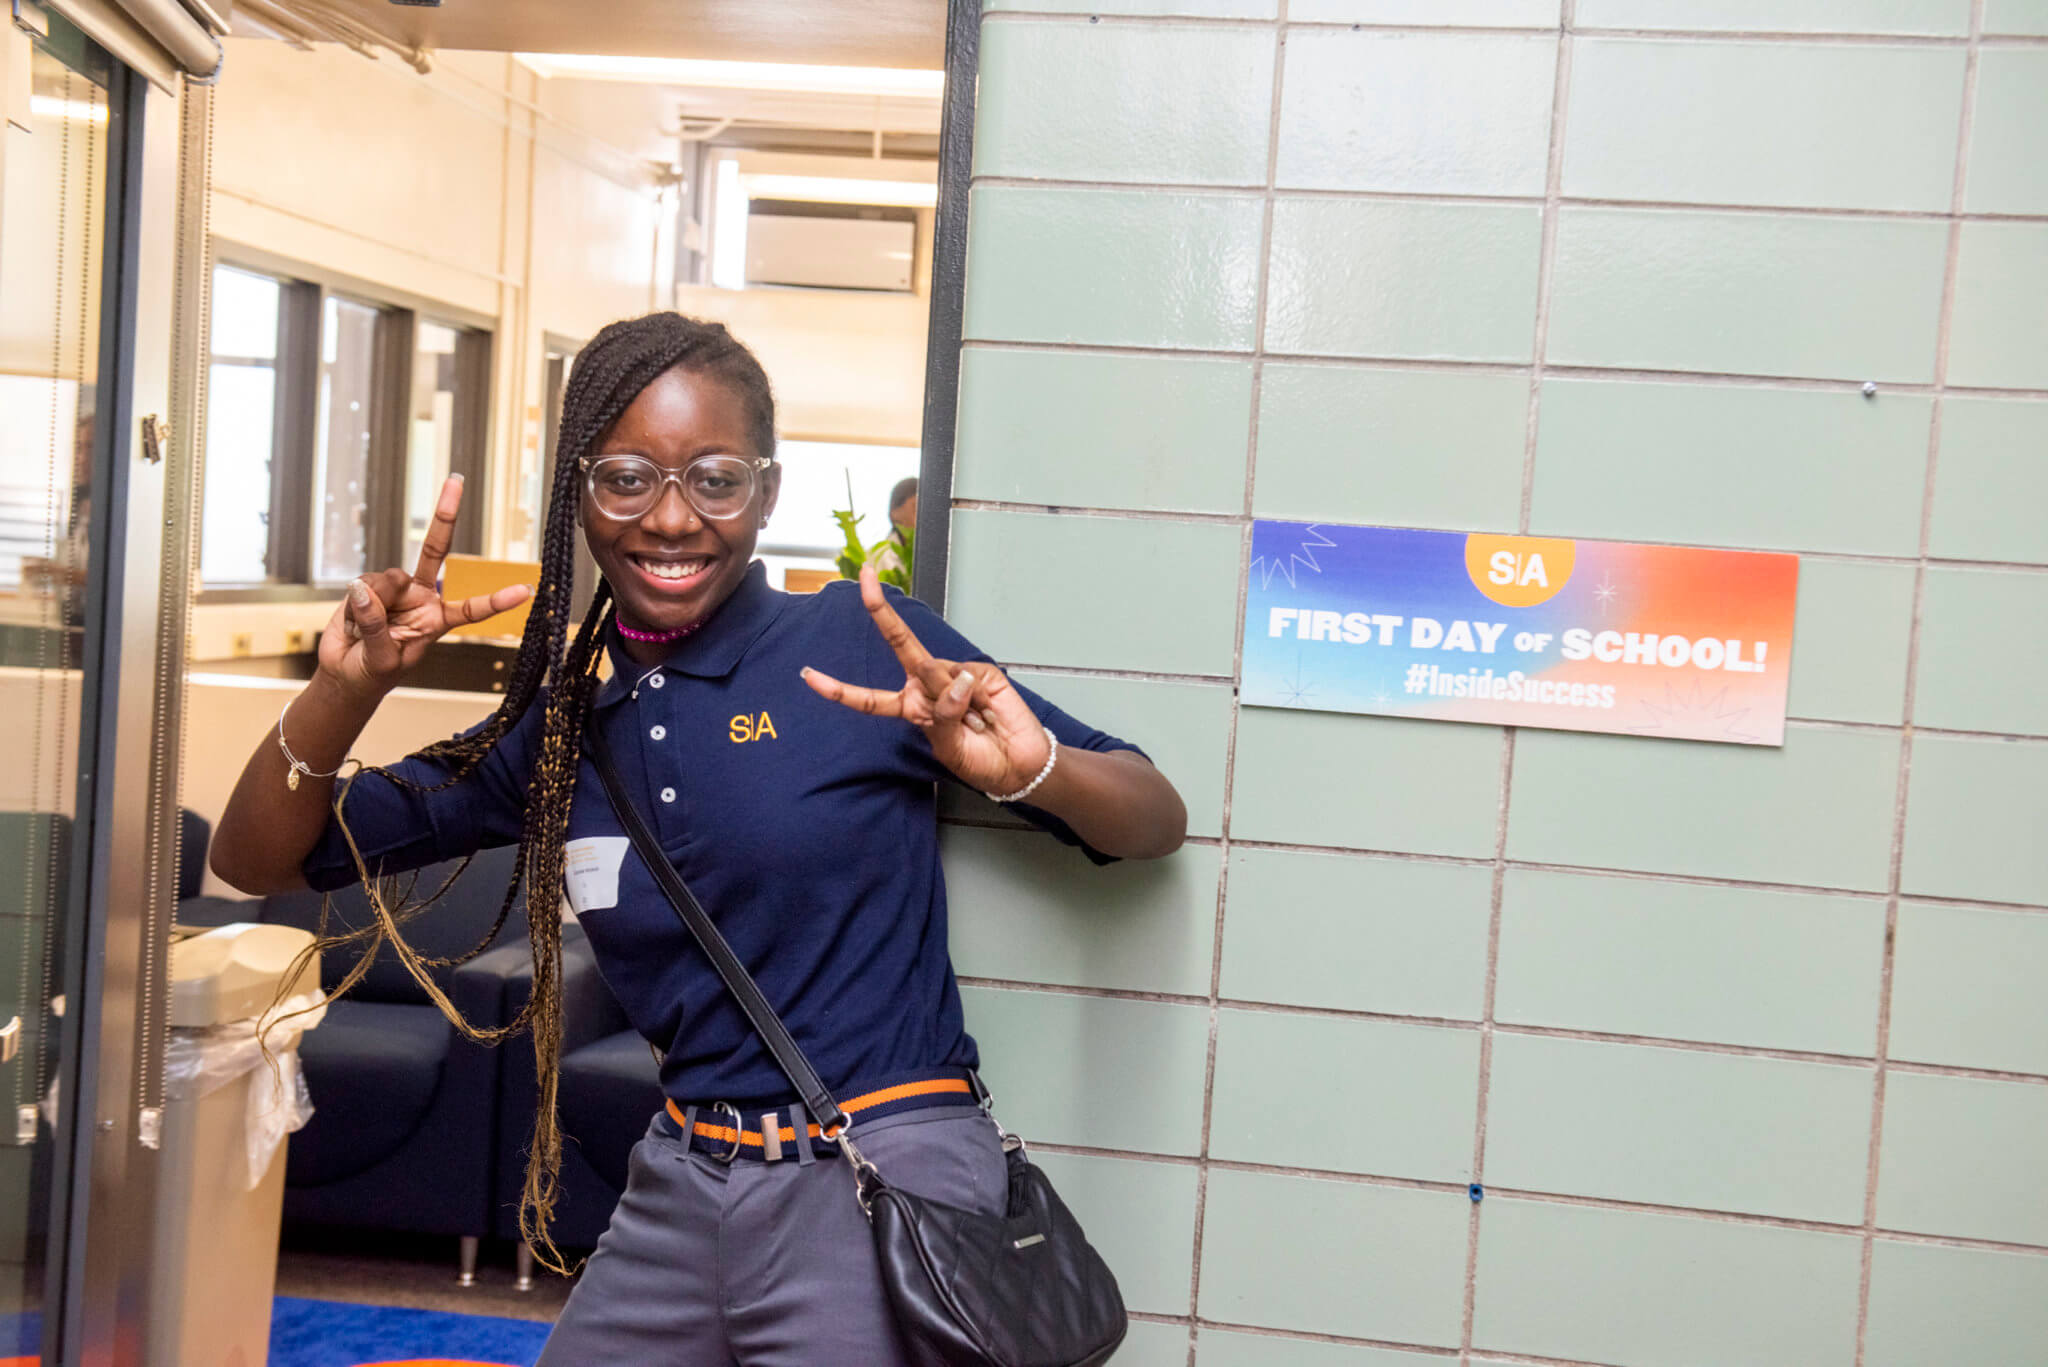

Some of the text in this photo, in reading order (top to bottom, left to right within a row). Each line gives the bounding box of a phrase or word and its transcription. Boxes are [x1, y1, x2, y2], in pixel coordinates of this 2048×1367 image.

[1268, 607, 1767, 673] FIRST DAY OF SCHOOL!
[1404, 664, 1615, 709] #InsideSuccess
